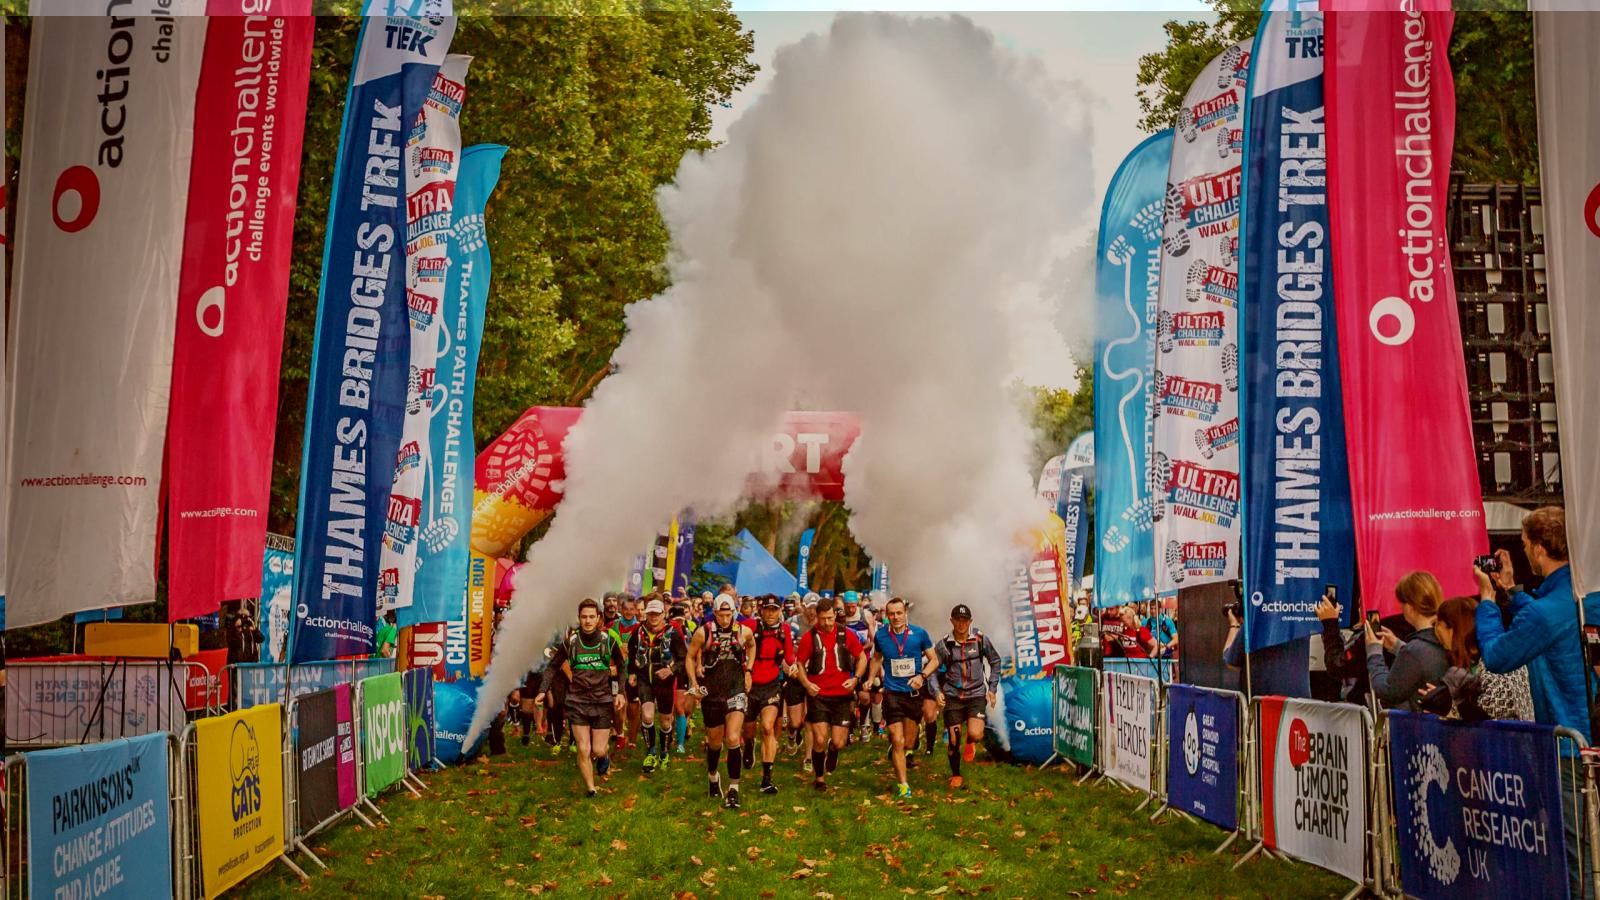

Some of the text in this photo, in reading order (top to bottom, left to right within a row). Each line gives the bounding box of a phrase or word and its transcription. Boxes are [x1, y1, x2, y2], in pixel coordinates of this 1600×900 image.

[1196, 94, 1235, 117] ULTRA
[246, 18, 285, 262] challenge events worldwide
[406, 187, 453, 224] LTRA
[1194, 197, 1240, 223] CHALLE
[1177, 315, 1221, 329] ULTRA
[1177, 328, 1221, 339] CHALLENGE
[321, 98, 402, 601] THAMES BRIDGES TREK
[1275, 105, 1326, 585] THAMES BRIDGES TREK
[440, 260, 474, 514] THAMES PATH CHALLENGE
[1167, 395, 1215, 413] CHALLENGE
[1169, 380, 1216, 403] ULTRA
[1209, 421, 1238, 439] ULTRA
[1174, 487, 1237, 515] CHALLENGE
[1177, 466, 1238, 500] ULTRA
[1186, 545, 1225, 559] ULTRA
[1186, 559, 1226, 568] CHALLENGE
[1029, 559, 1066, 667] ULTRA
[1115, 674, 1147, 721] HELP for
[367, 700, 403, 764] NSPCC
[1116, 713, 1147, 760] HEROES
[1293, 729, 1307, 752] The
[1309, 732, 1348, 771] BRAIN
[53, 766, 134, 835] PARKINSON'S
[231, 775, 261, 822] CATS
[1295, 767, 1349, 808] TUMOUR
[1456, 767, 1526, 809] CANCER
[233, 815, 262, 840] PROTECTION
[1294, 798, 1349, 844] CHARITY
[1462, 806, 1548, 857] RESEARCH
[54, 826, 103, 878] CHANGE
[1467, 846, 1490, 882] UK
